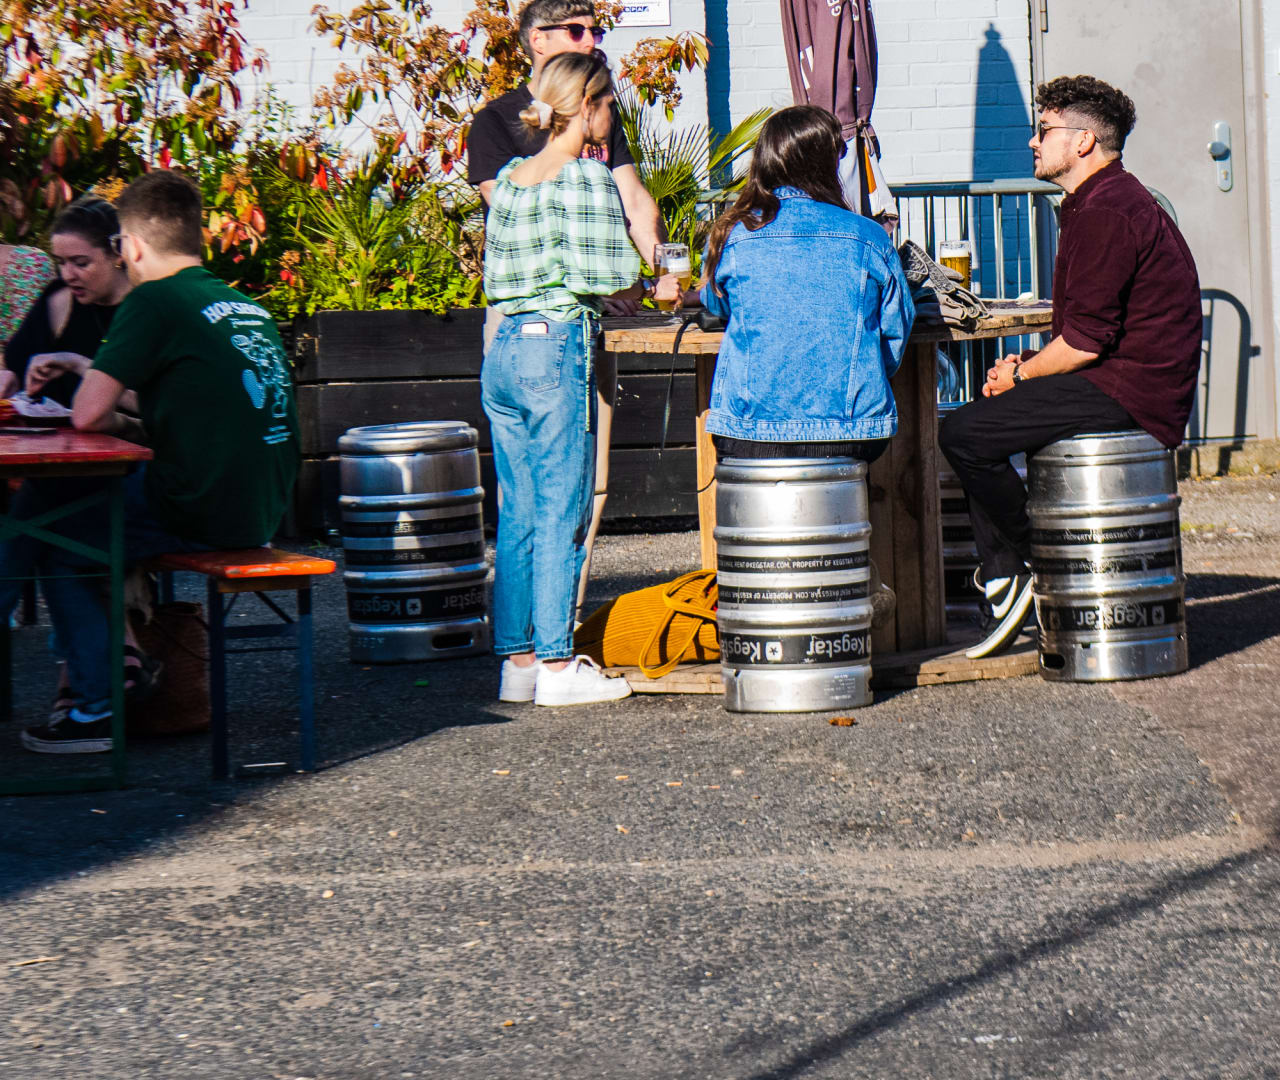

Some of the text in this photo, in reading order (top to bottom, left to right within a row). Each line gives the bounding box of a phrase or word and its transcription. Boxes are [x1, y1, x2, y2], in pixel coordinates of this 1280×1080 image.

[792, 559, 824, 568] PROPERTY
[824, 559, 832, 567] OF
[442, 588, 486, 609] egstar
[762, 591, 793, 600] PROPERTY
[721, 636, 761, 660] Kegsta
[806, 633, 865, 658] Kegstar
